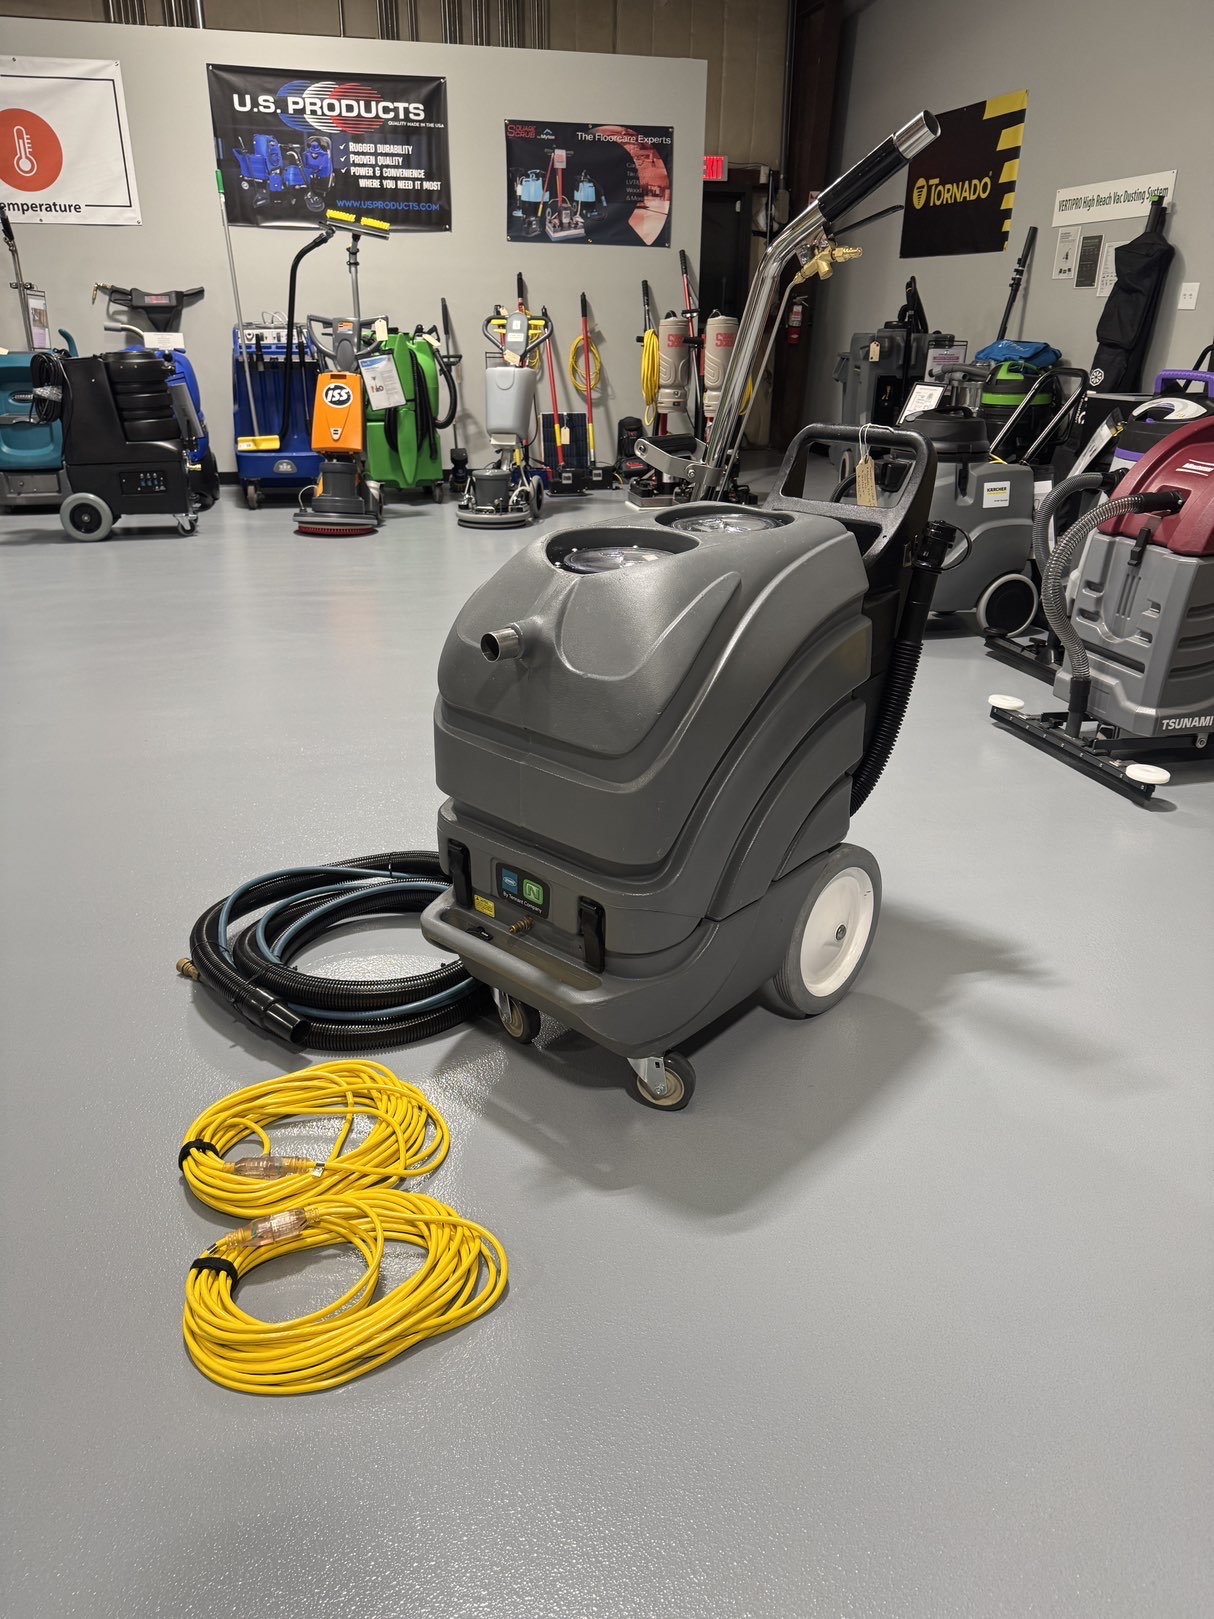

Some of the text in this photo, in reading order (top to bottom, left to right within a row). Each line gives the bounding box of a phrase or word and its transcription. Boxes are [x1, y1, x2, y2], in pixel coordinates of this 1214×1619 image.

[232, 93, 426, 121] U.S. PRODUCTS
[576, 131, 672, 145] The Floorcare Experts
[348, 141, 413, 155] RUGGED DURABILITY
[349, 154, 403, 167] PROVEN QUALITY
[350, 166, 425, 179] POWER & CONVENIENCE
[358, 178, 442, 191] WHERE YOU NEED IT MOST
[336, 199, 440, 211] WWW.USPRODUCTS.COM
[1058, 197, 1083, 212] VERTIPRO
[1082, 194, 1096, 212] High
[1095, 192, 1112, 207] Reach
[1111, 191, 1122, 204] Vac
[1122, 188, 1147, 204] Dusting
[1161, 715, 1214, 730] TSUNAMI
[523, 900, 543, 914] Company
